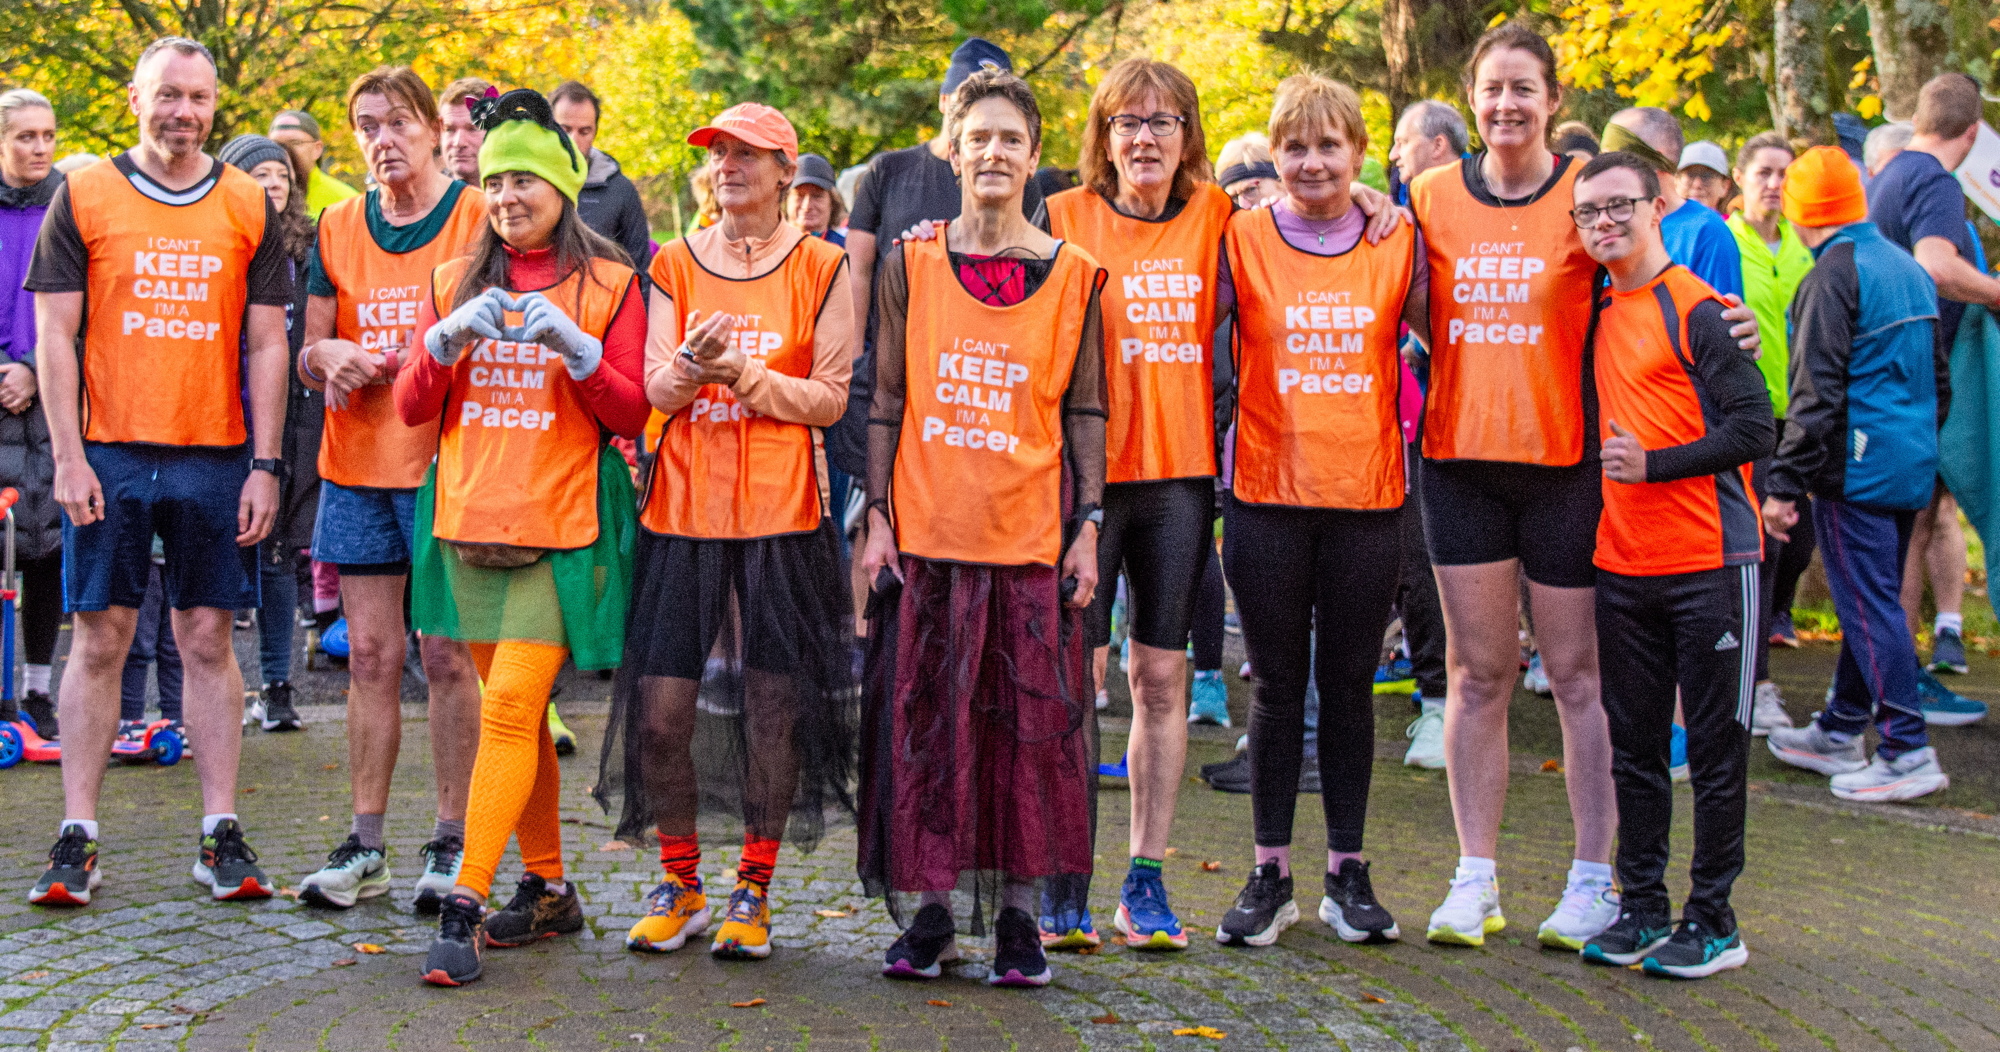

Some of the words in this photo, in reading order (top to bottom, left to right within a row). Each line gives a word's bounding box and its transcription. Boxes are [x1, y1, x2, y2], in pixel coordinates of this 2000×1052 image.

[148, 236, 153, 249] I
[156, 237, 202, 252] CAN'T
[1470, 242, 1475, 254] I
[1478, 242, 1525, 255] CAN'T
[134, 250, 223, 279] KEEP
[1133, 260, 1138, 273] I
[1141, 258, 1183, 273] CAN'T
[1454, 256, 1545, 280] KEEP
[133, 278, 208, 302] CALM
[369, 288, 375, 300] I
[377, 285, 420, 300] CAN'T
[1122, 273, 1203, 299] KEEP
[1298, 291, 1303, 304] I
[1306, 290, 1351, 304] CAN'T
[1452, 282, 1529, 304] CALM
[154, 303, 175, 316] I'M
[178, 304, 190, 317] A
[357, 301, 424, 327] KEE
[1126, 301, 1196, 323] CALM
[1285, 305, 1376, 329] KEEP
[1473, 307, 1495, 320] I'M
[1498, 307, 1509, 320] A
[122, 310, 221, 341] Pacer
[1149, 326, 1168, 339] I'M
[1170, 326, 1180, 339] A
[1448, 318, 1544, 345] Pacer
[953, 337, 959, 350] I
[962, 338, 1010, 357] CAN'T
[1286, 333, 1363, 354] CALM
[938, 352, 1029, 388] KEEP
[1309, 357, 1330, 370] I'M
[1333, 357, 1345, 370] A
[470, 366, 545, 389] CALM
[1278, 368, 1374, 394] Pacer
[491, 391, 511, 405] I'M
[514, 392, 524, 405] A
[935, 382, 1011, 413] CALM
[461, 400, 556, 431] Pacer
[956, 409, 975, 424] I'M
[979, 412, 991, 426] A
[922, 416, 1020, 454] Pacer
